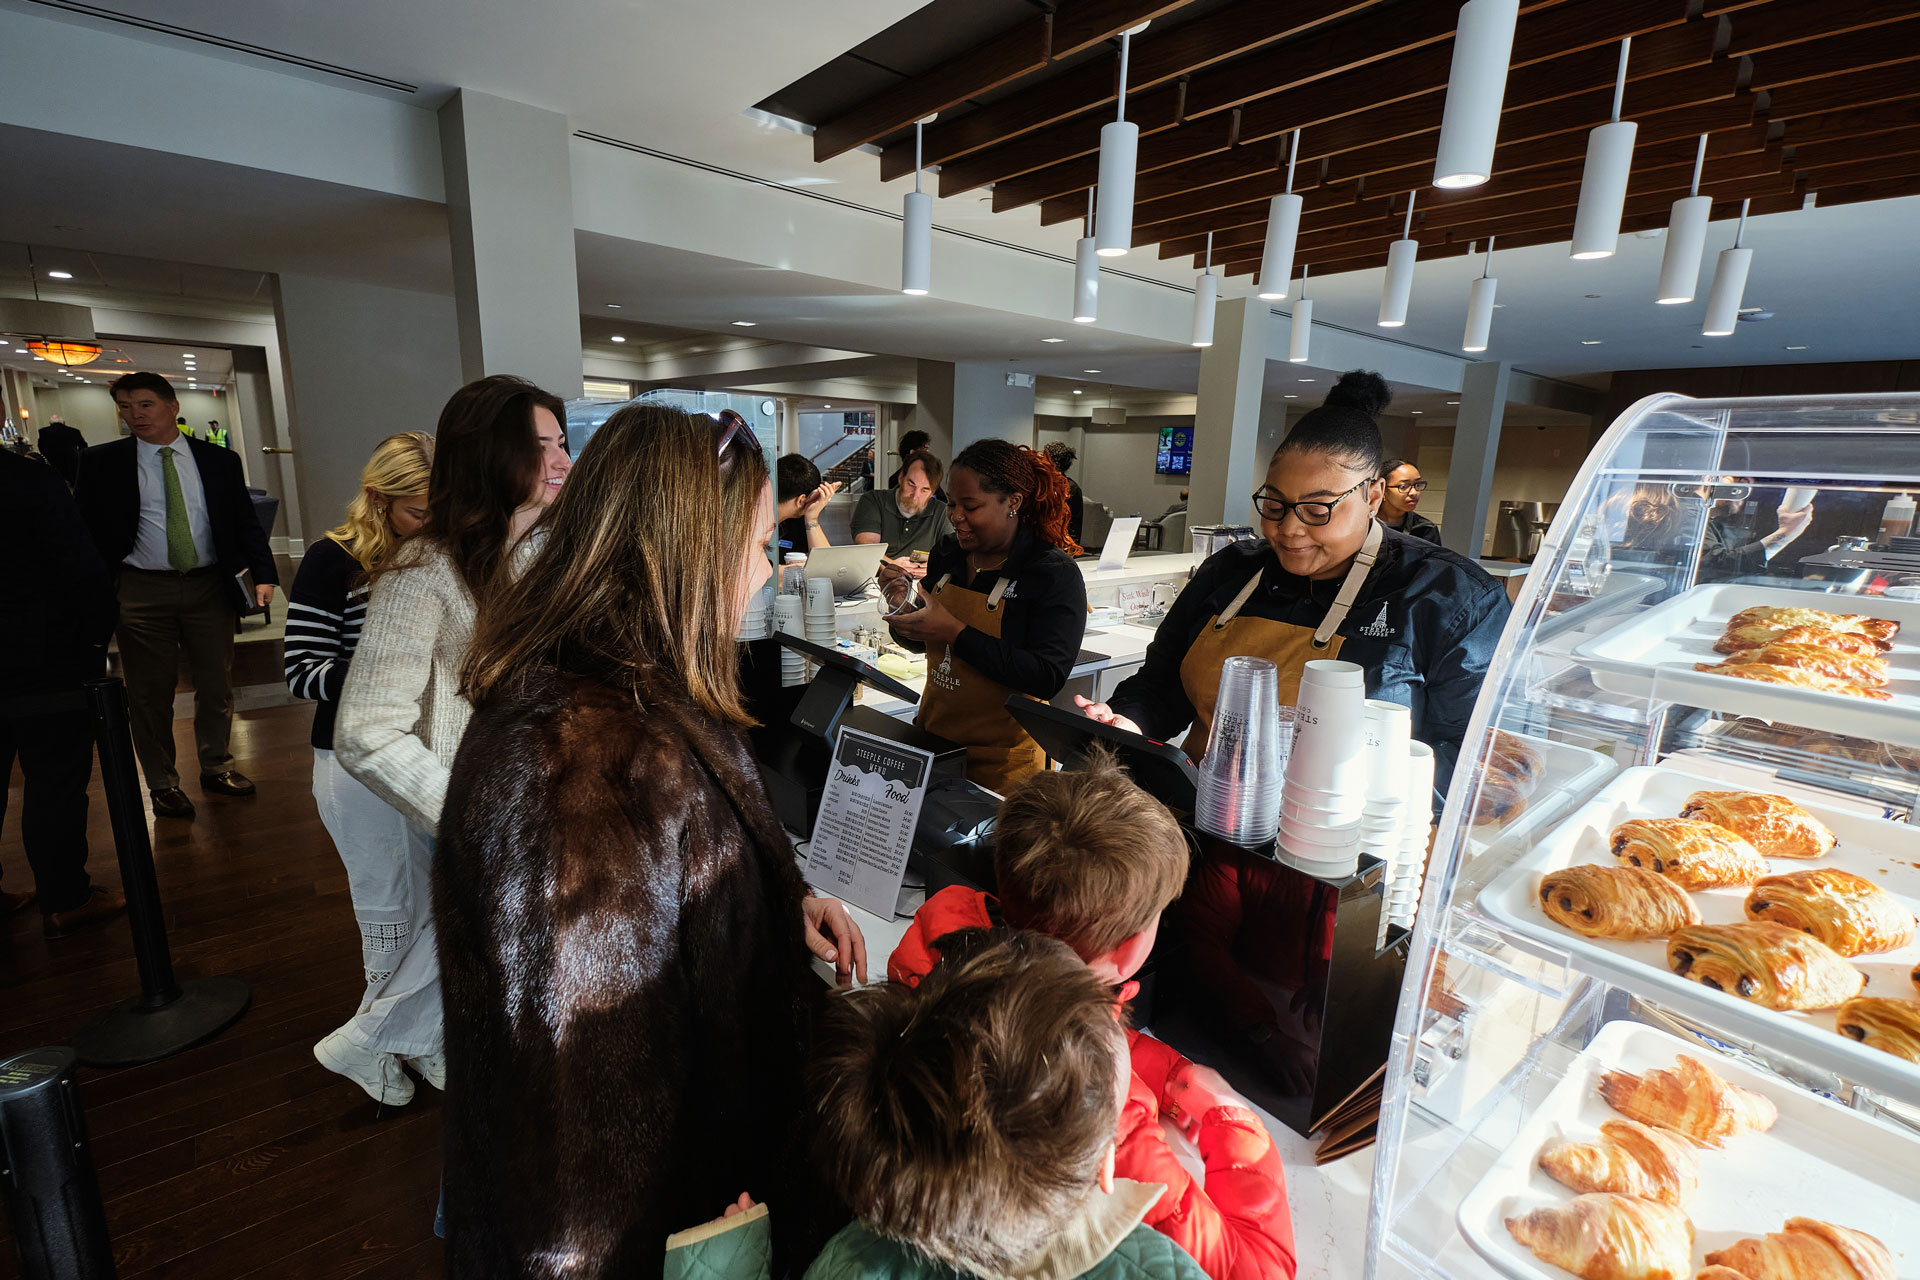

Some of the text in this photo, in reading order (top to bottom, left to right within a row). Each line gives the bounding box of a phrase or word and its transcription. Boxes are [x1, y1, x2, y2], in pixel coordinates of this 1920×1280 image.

[1360, 626, 1396, 634] STEEPLE
[931, 668, 960, 687] STEEPLE
[856, 748, 906, 771] STEEPLE COFFEE
[834, 769, 861, 787] Drinks
[868, 762, 887, 776] MENU
[885, 783, 910, 805] Food
